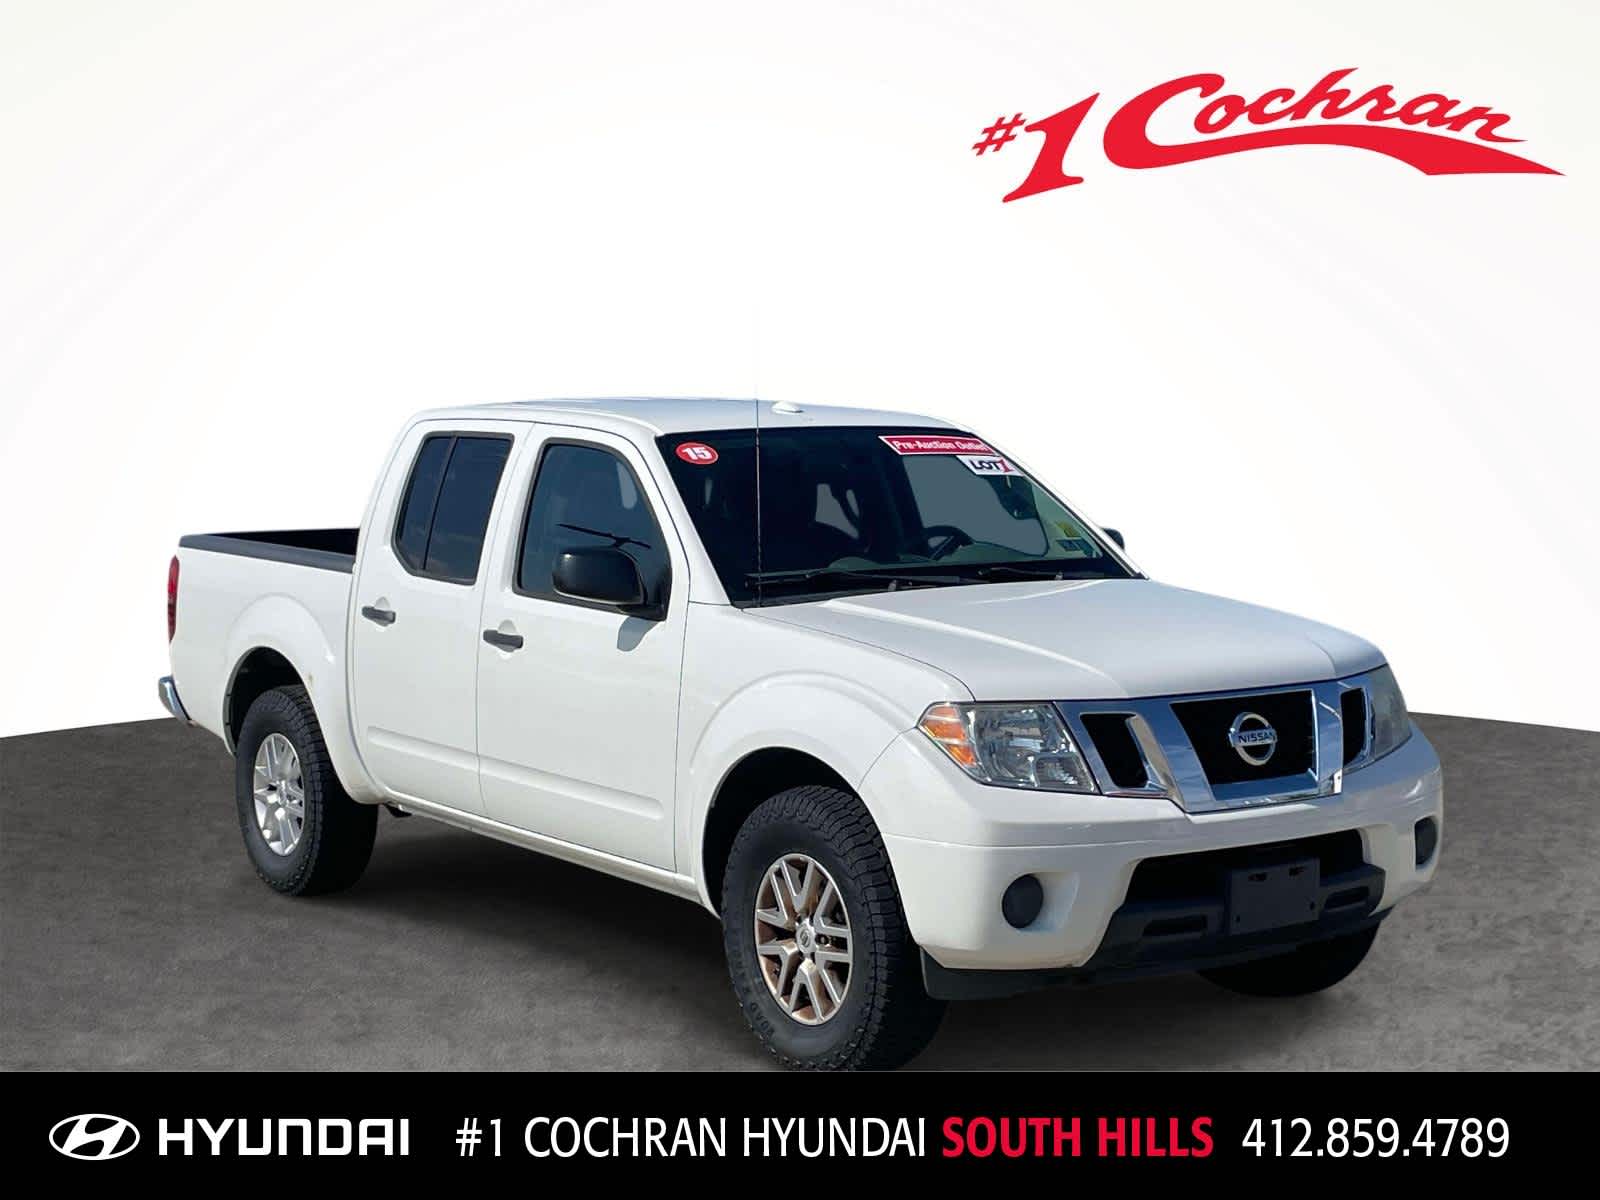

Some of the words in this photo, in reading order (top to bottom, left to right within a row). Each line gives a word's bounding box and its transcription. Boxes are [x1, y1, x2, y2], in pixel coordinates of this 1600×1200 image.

[892, 440, 955, 450] Pre-Auction
[682, 447, 713, 460] 15
[1238, 731, 1274, 743] NISSAN
